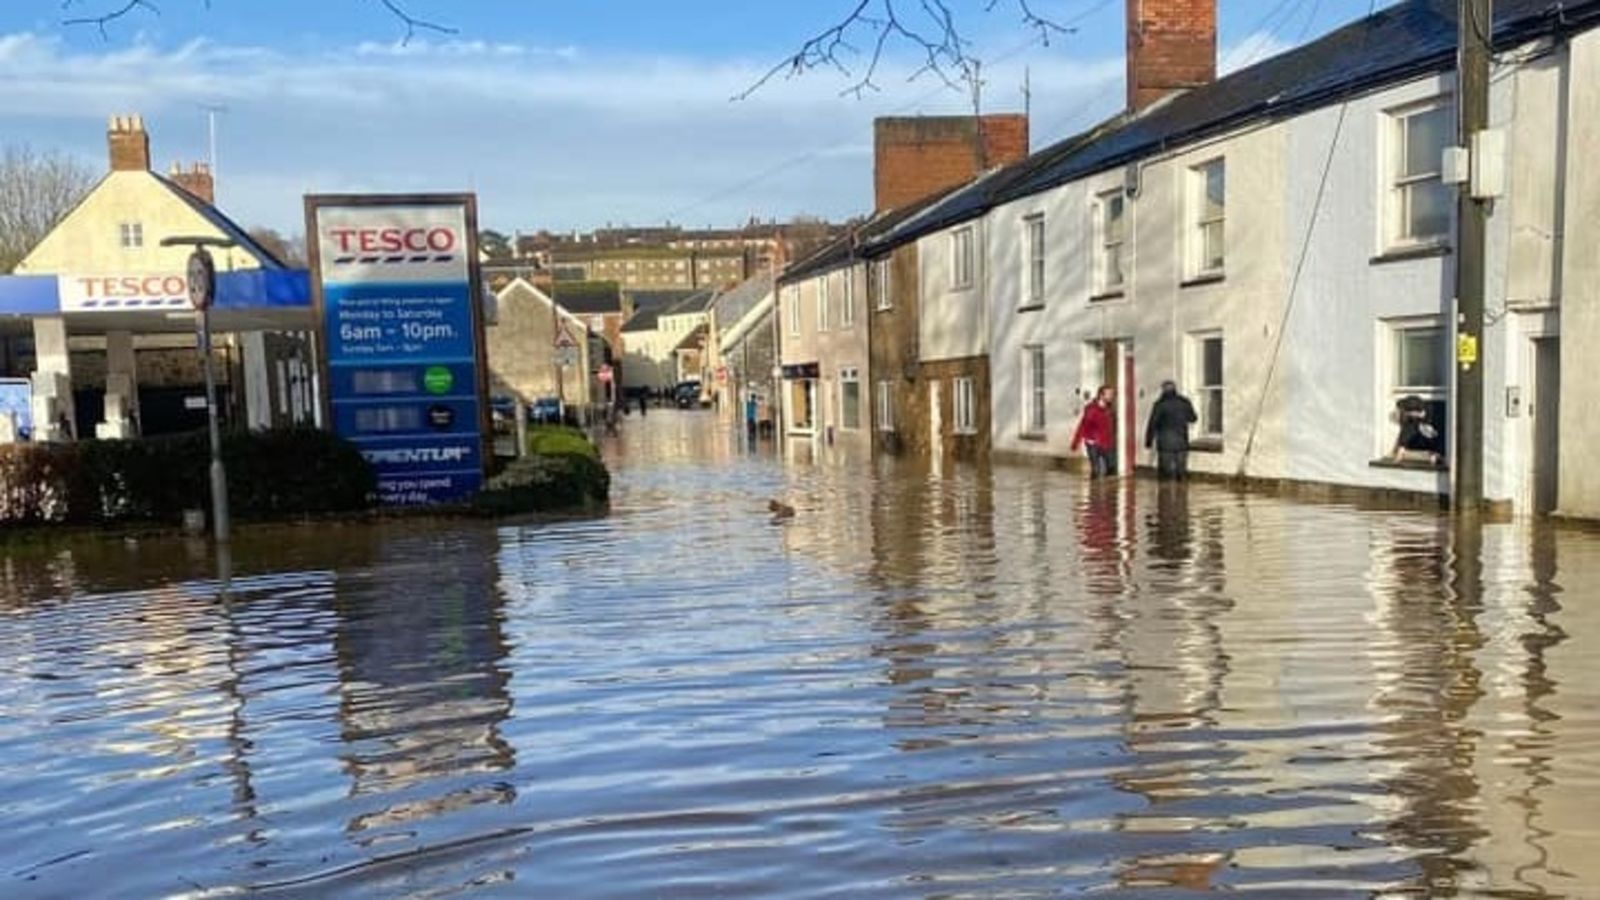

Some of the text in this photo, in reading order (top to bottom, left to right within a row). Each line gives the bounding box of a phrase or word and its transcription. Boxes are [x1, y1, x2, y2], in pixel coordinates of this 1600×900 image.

[331, 227, 455, 252] TESCO
[79, 275, 187, 297] TESCO
[340, 323, 382, 340] 6am
